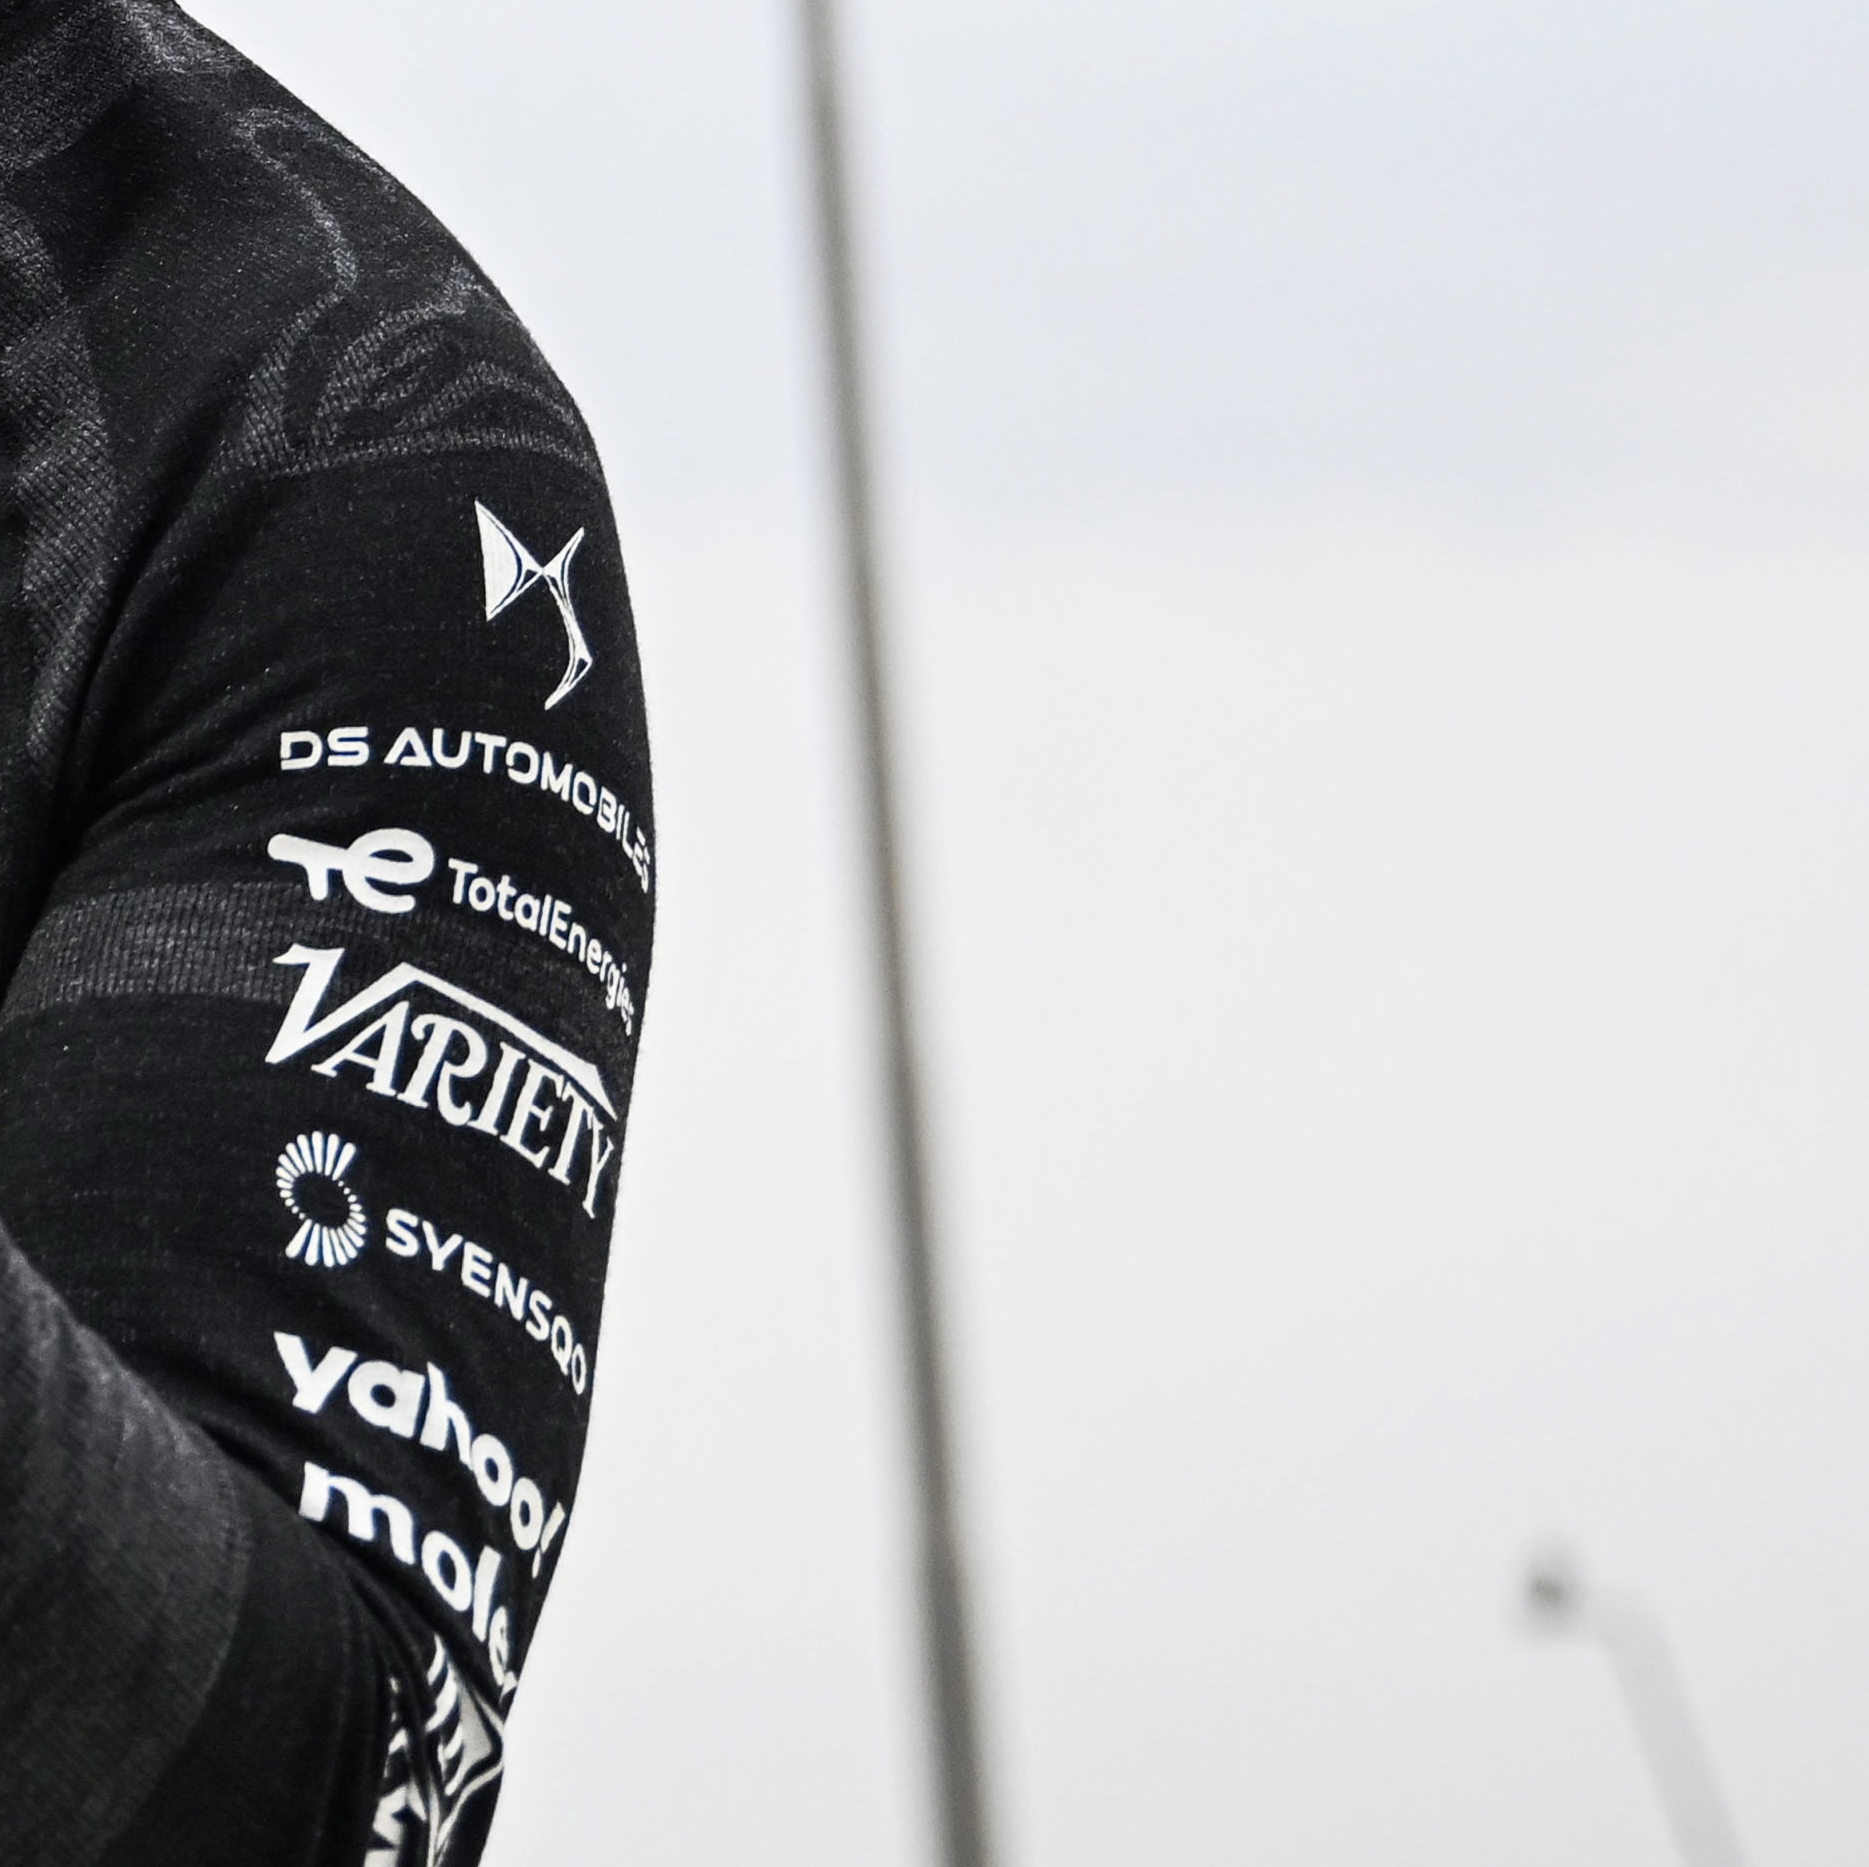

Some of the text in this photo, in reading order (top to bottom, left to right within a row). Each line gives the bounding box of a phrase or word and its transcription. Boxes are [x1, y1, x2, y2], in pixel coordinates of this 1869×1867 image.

[280, 727, 651, 895] DS AUTOMOBILES
[448, 858, 635, 1037] TotalEnergies
[265, 943, 618, 1219] VARIETY
[385, 1208, 588, 1395] SYENSQO
[273, 1331, 566, 1579] yahoo!
